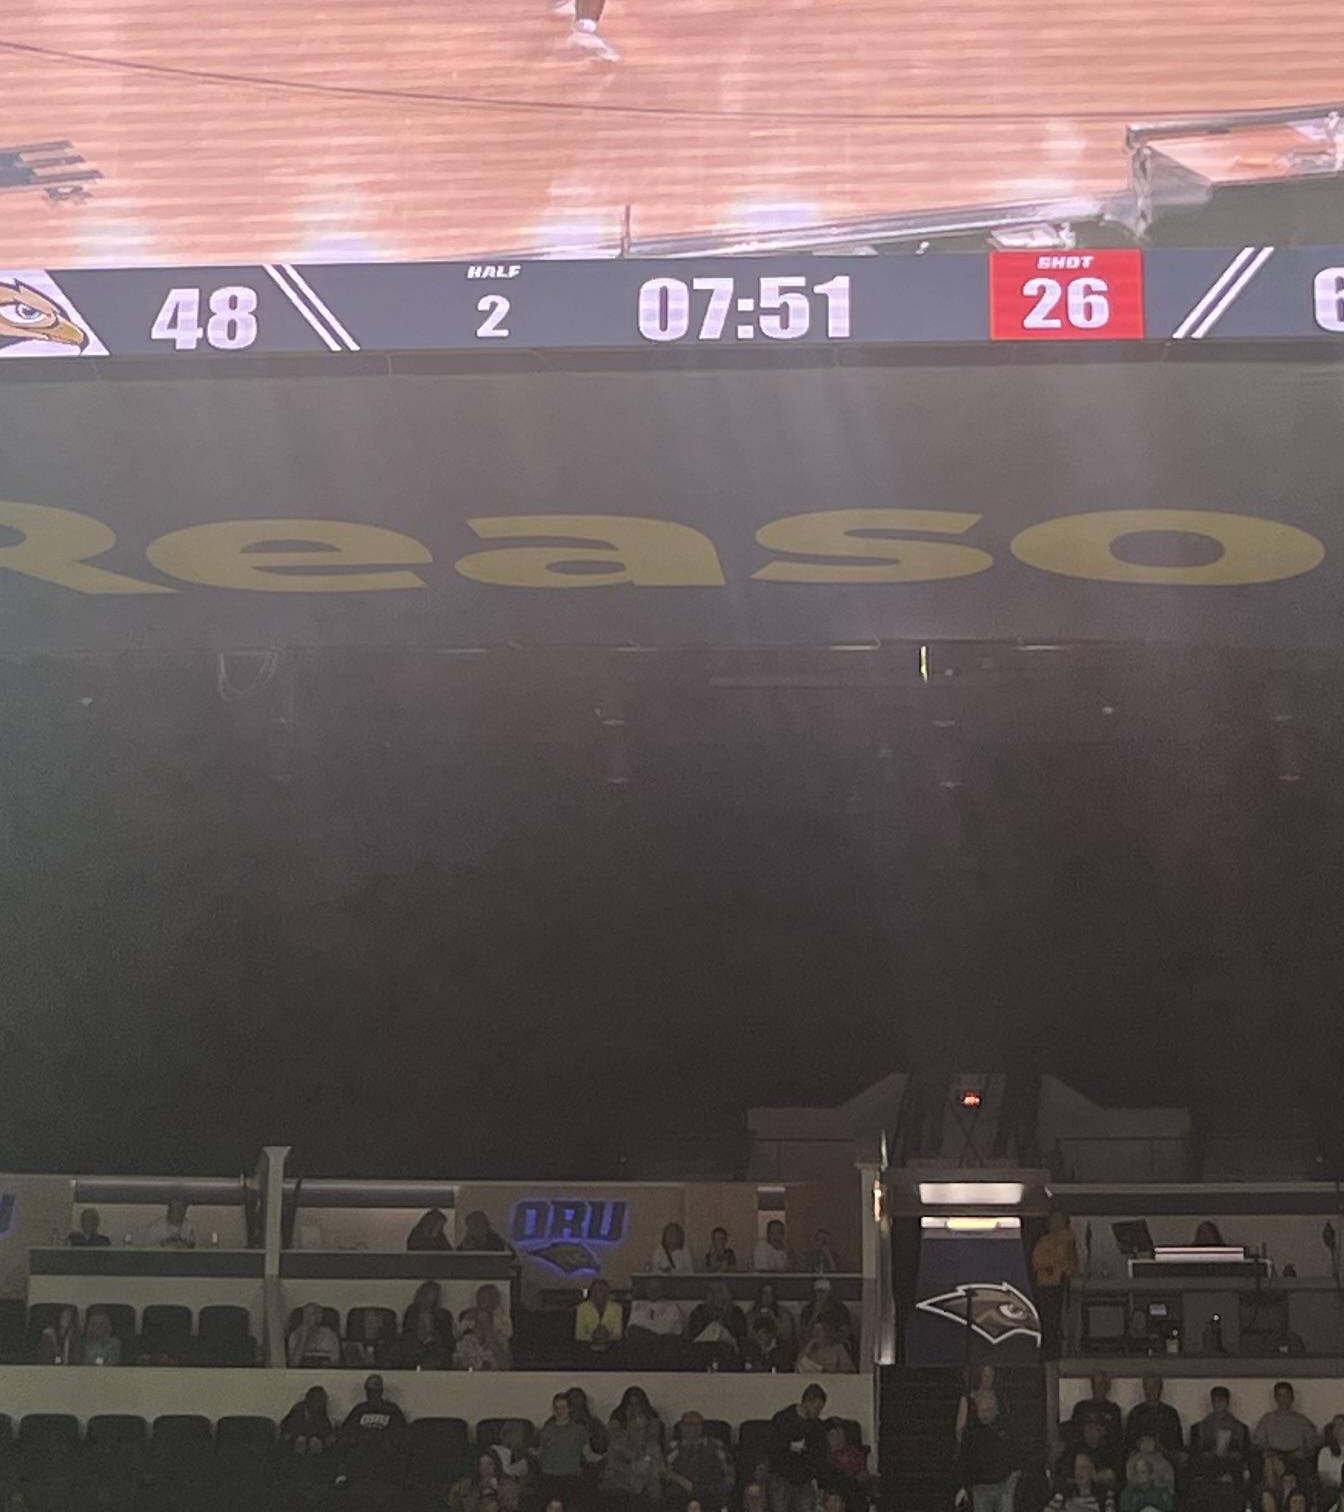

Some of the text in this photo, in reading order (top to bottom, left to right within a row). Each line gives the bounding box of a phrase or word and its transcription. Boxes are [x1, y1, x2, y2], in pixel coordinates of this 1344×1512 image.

[466, 265, 521, 279] HALF
[1038, 256, 1094, 269] SHOT
[151, 288, 257, 350] 48
[477, 295, 510, 338] 2
[638, 276, 852, 342] 07:51
[1022, 277, 1110, 330] 26
[513, 1200, 628, 1242] ORU
